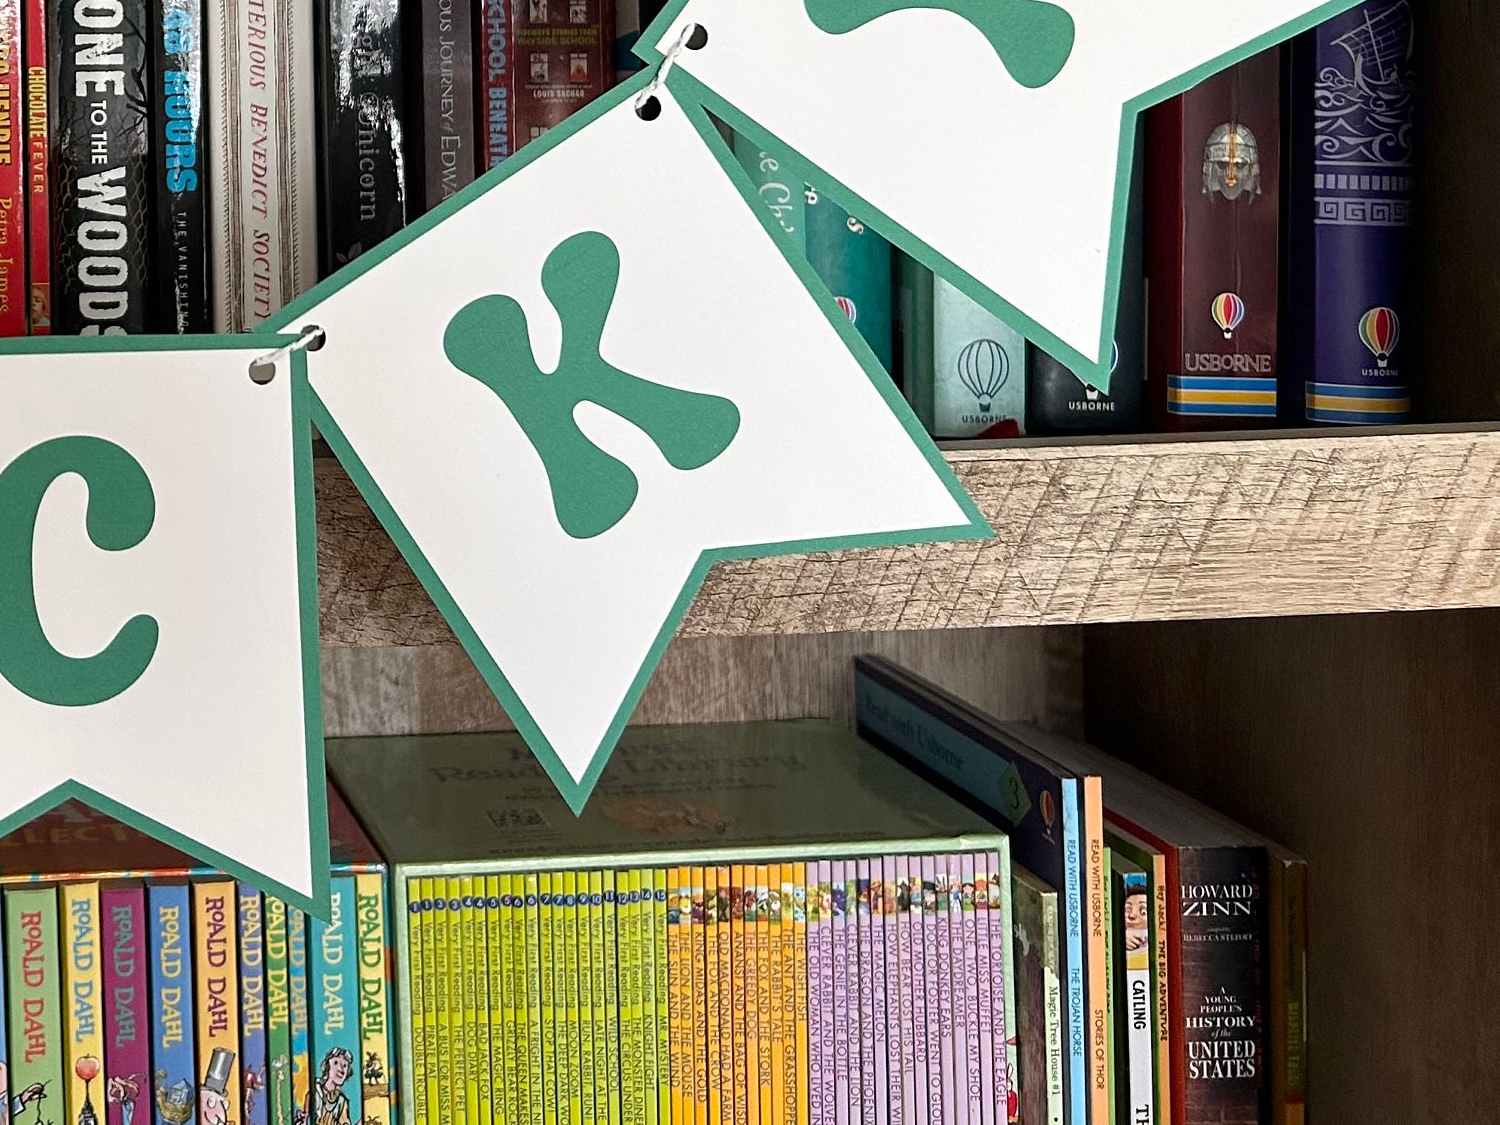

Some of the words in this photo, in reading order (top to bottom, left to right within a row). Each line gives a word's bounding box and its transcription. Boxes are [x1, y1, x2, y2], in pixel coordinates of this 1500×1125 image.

[28, 66, 48, 138] CHOCOLATE
[439, 36, 454, 124] JOURNEY
[90, 101, 107, 125] TO
[164, 71, 198, 193] HOURS
[33, 141, 44, 194] FEVER
[91, 131, 108, 165] THE
[250, 103, 269, 219] BENEDICT
[444, 231, 740, 539] K
[1185, 353, 1271, 373] USBORNE
[1068, 401, 1115, 411] USBORNE
[1180, 885, 1253, 899] HOWARD
[1182, 901, 1251, 916] ZINN
[21, 911, 44, 988] ROALD
[72, 898, 94, 972] ROALD
[112, 905, 135, 978] ROALD
[159, 905, 182, 979] ROALD
[205, 895, 227, 967] ROALD
[359, 894, 382, 968] ROALD
[874, 951, 885, 995] MAGIC
[23, 997, 46, 1064] DAHL
[74, 980, 94, 1043] DAHL
[115, 986, 136, 1048] DAHL
[161, 986, 183, 1049] DAHL
[207, 977, 228, 1038] DAHL
[361, 978, 384, 1041] DAHL
[875, 999, 886, 1043] MELON
[1071, 986, 1081, 1026] TROJAN
[1094, 1009, 1104, 1044] STORIES
[1132, 979, 1147, 1030] CATLING
[1186, 1016, 1256, 1028] HISTORY
[915, 1006, 926, 1063] HUBBARD
[1072, 1028, 1082, 1057] HORSE
[1188, 1040, 1256, 1059] UNITED
[1095, 1065, 1105, 1090] THOR
[1189, 1059, 1256, 1079] STATES
